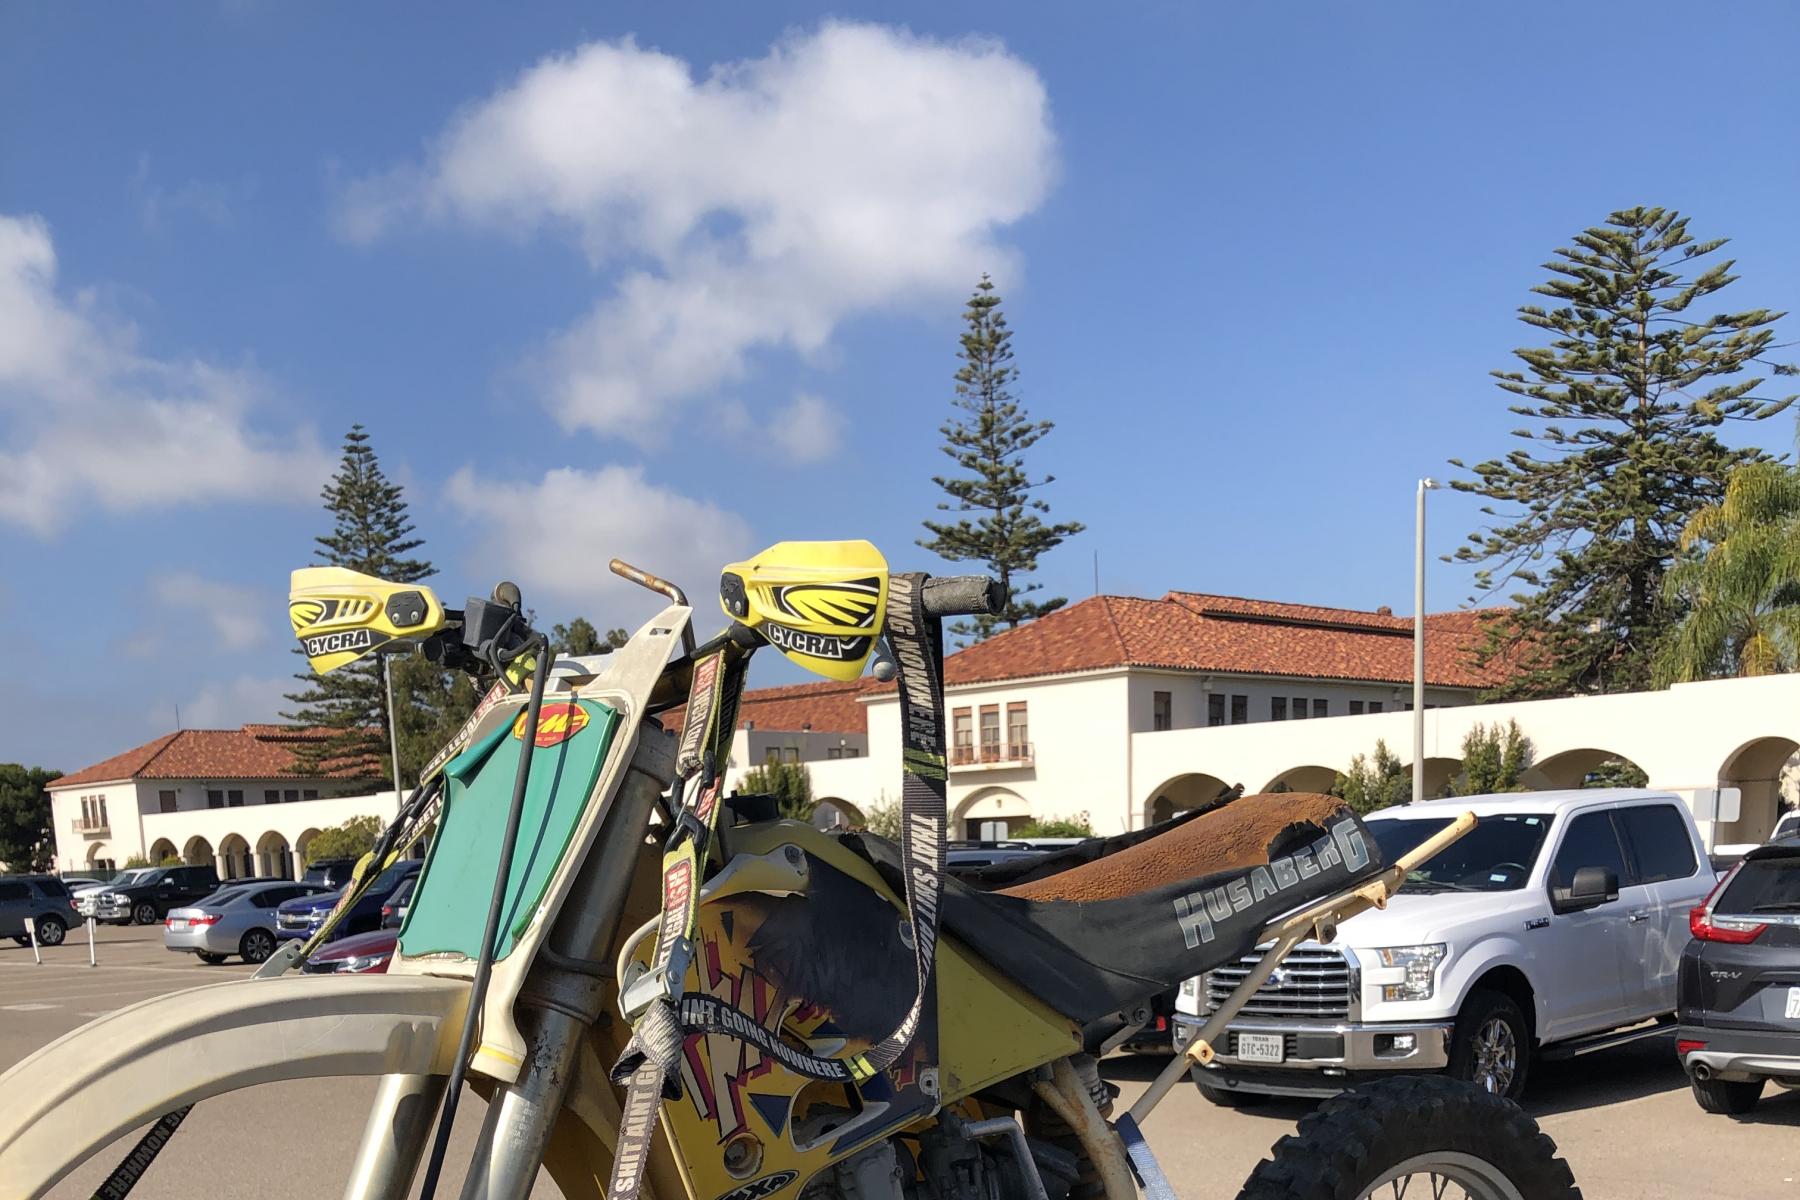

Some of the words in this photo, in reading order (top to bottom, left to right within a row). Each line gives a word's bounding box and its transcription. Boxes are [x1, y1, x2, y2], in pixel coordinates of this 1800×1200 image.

[886, 573, 917, 636] OING
[308, 628, 372, 656] CYCRA
[766, 621, 844, 660] CYCRA
[893, 635, 938, 754] NOWHERE
[910, 812, 939, 872] THAT
[913, 867, 938, 927] SHIT
[1173, 817, 1370, 950] HUSABERG
[680, 998, 717, 1026] INT
[720, 1007, 770, 1049] GOING
[768, 1034, 848, 1078] NOWHERE
[627, 1090, 653, 1138] AINT
[615, 1142, 643, 1193] SHIT
